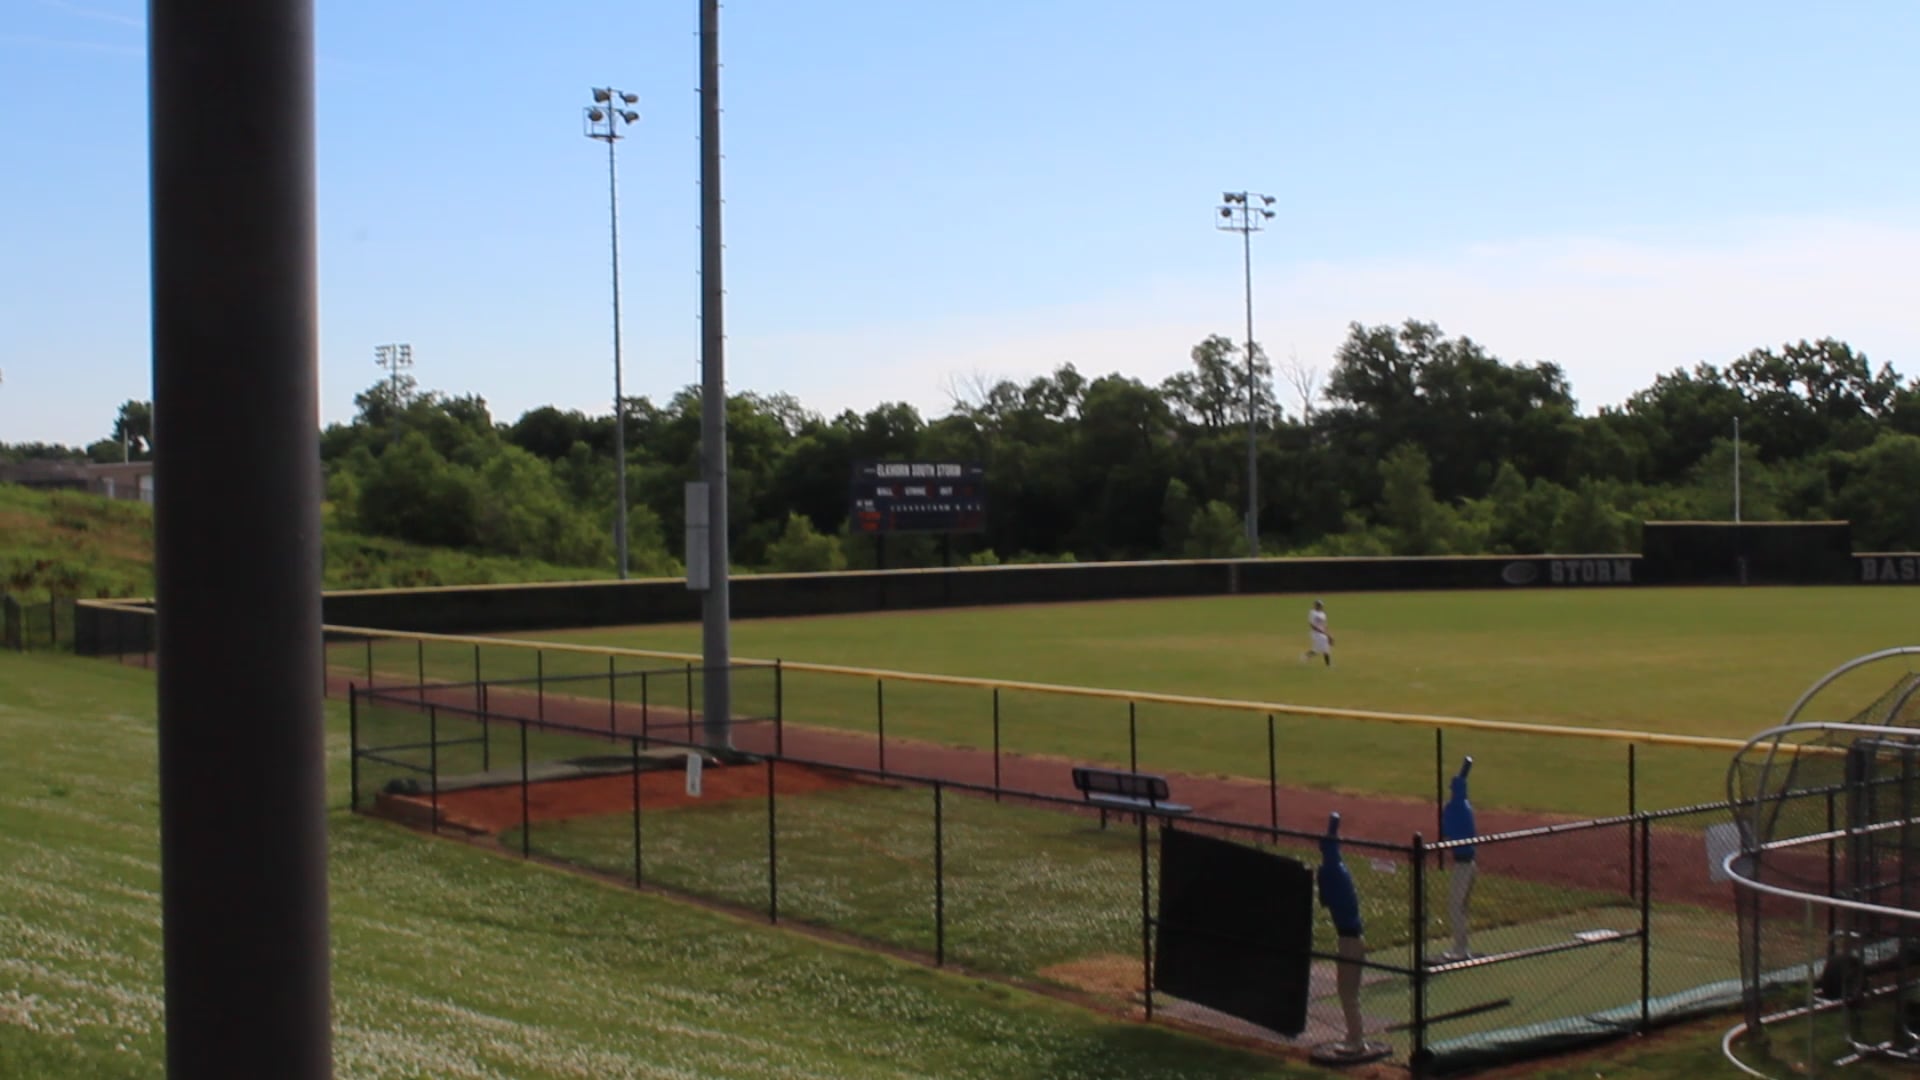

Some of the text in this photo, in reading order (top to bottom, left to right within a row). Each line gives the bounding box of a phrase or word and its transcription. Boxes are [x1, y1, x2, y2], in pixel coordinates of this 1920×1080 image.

[876, 463, 962, 477] ELKHORN SOUTH STORM
[1551, 560, 1632, 582] STORM
[1860, 558, 1920, 580] BAS
